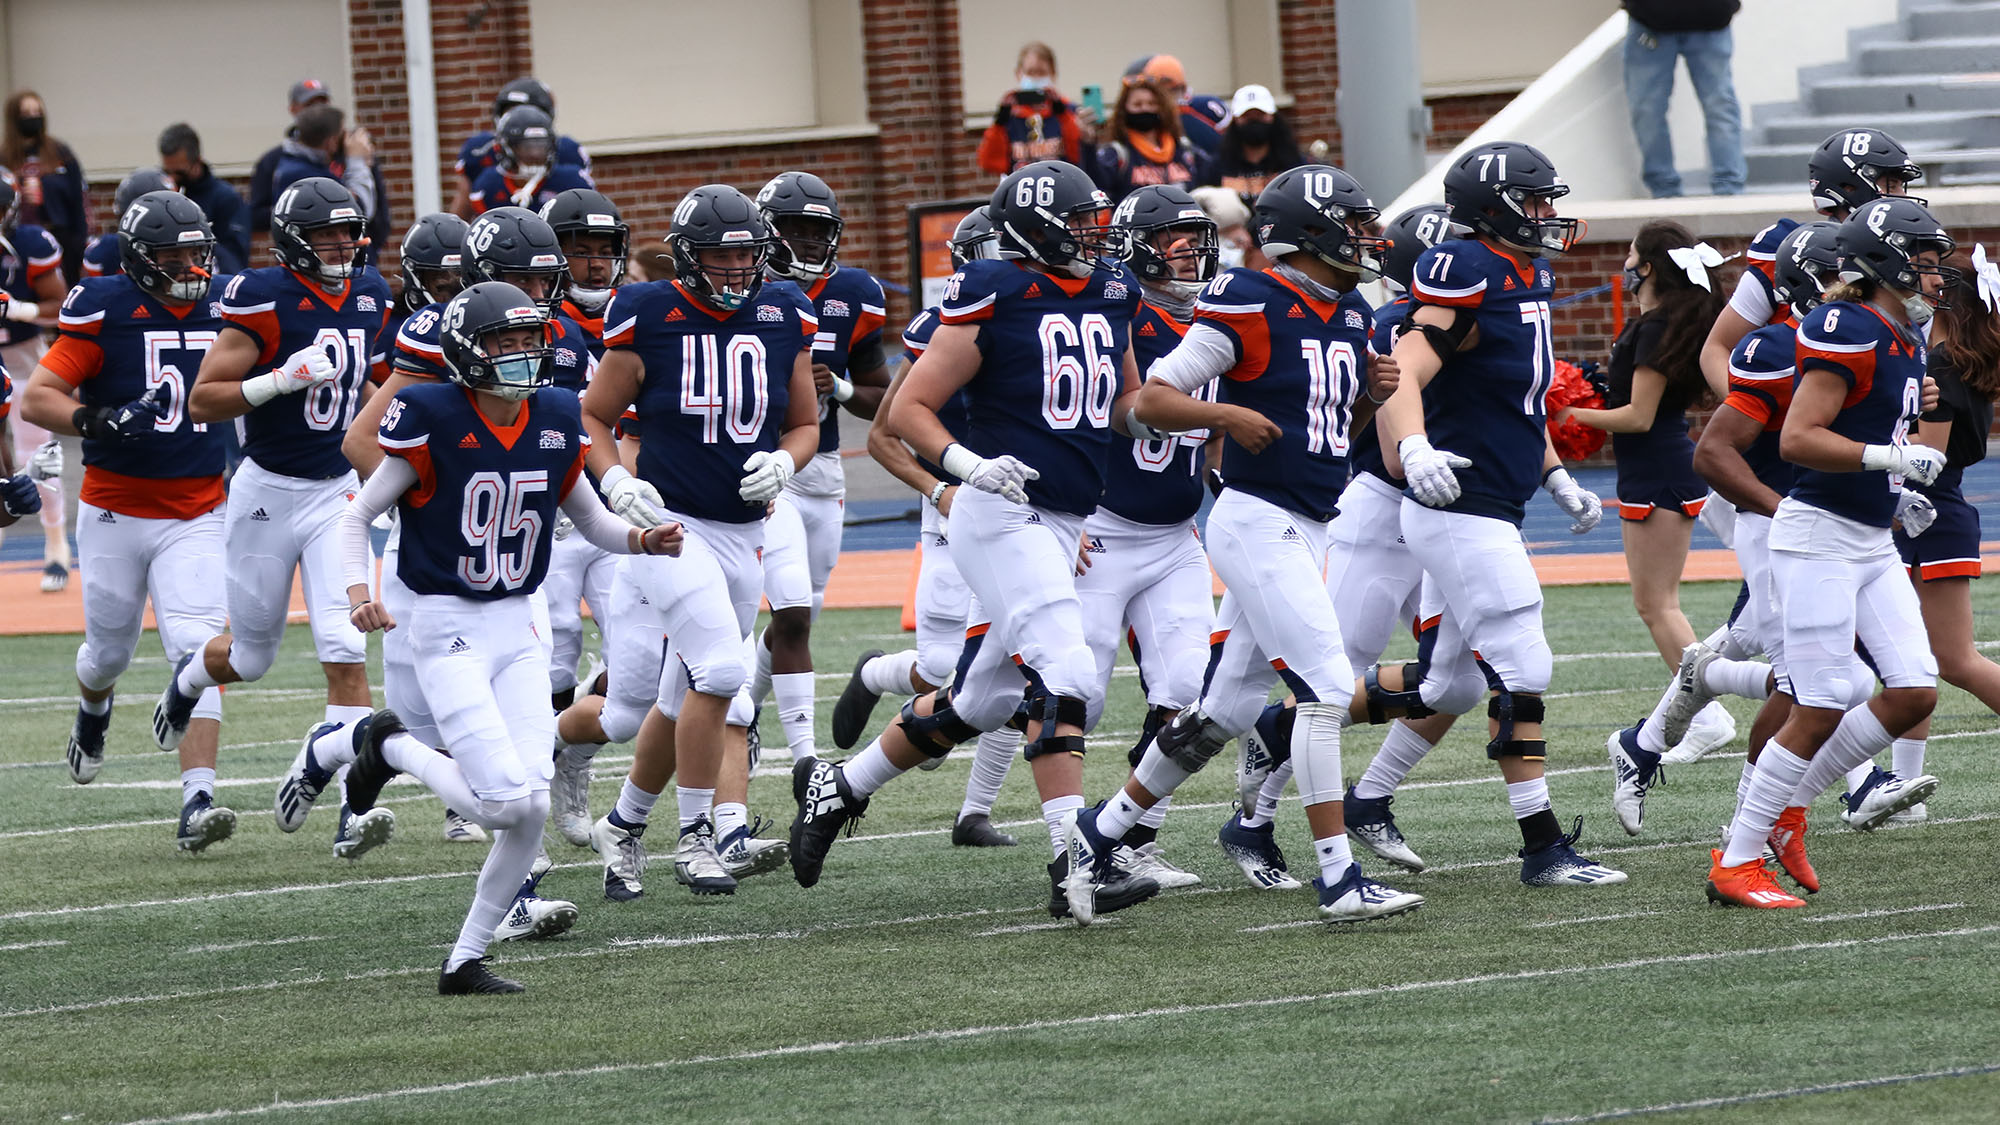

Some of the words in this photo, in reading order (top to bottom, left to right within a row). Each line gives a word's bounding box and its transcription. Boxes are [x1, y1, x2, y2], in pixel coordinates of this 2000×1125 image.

[1842, 133, 1872, 155] 18
[1478, 154, 1507, 182] 71
[1016, 177, 1055, 207] 66
[1302, 173, 1333, 198] 10
[121, 203, 149, 233] 57
[1415, 213, 1450, 246] 61
[1867, 204, 1892, 228] 6
[466, 218, 500, 252] 56
[1792, 231, 1815, 256] 4
[1429, 252, 1454, 282] 71
[1207, 274, 1234, 300] 10
[409, 310, 440, 335] 56
[440, 297, 470, 333] 95
[1823, 309, 1841, 333] 6
[1519, 301, 1555, 415] 71
[1743, 338, 1763, 364] 4
[302, 328, 366, 431] 81
[1038, 314, 1116, 429] 66
[681, 334, 768, 443] 40
[1300, 338, 1359, 458] 10
[379, 398, 407, 432] 95
[457, 470, 549, 592] 95
[1245, 738, 1257, 776] adidas
[803, 762, 831, 825] adidas
[725, 850, 750, 863] adidas
[508, 915, 532, 928] adidas
